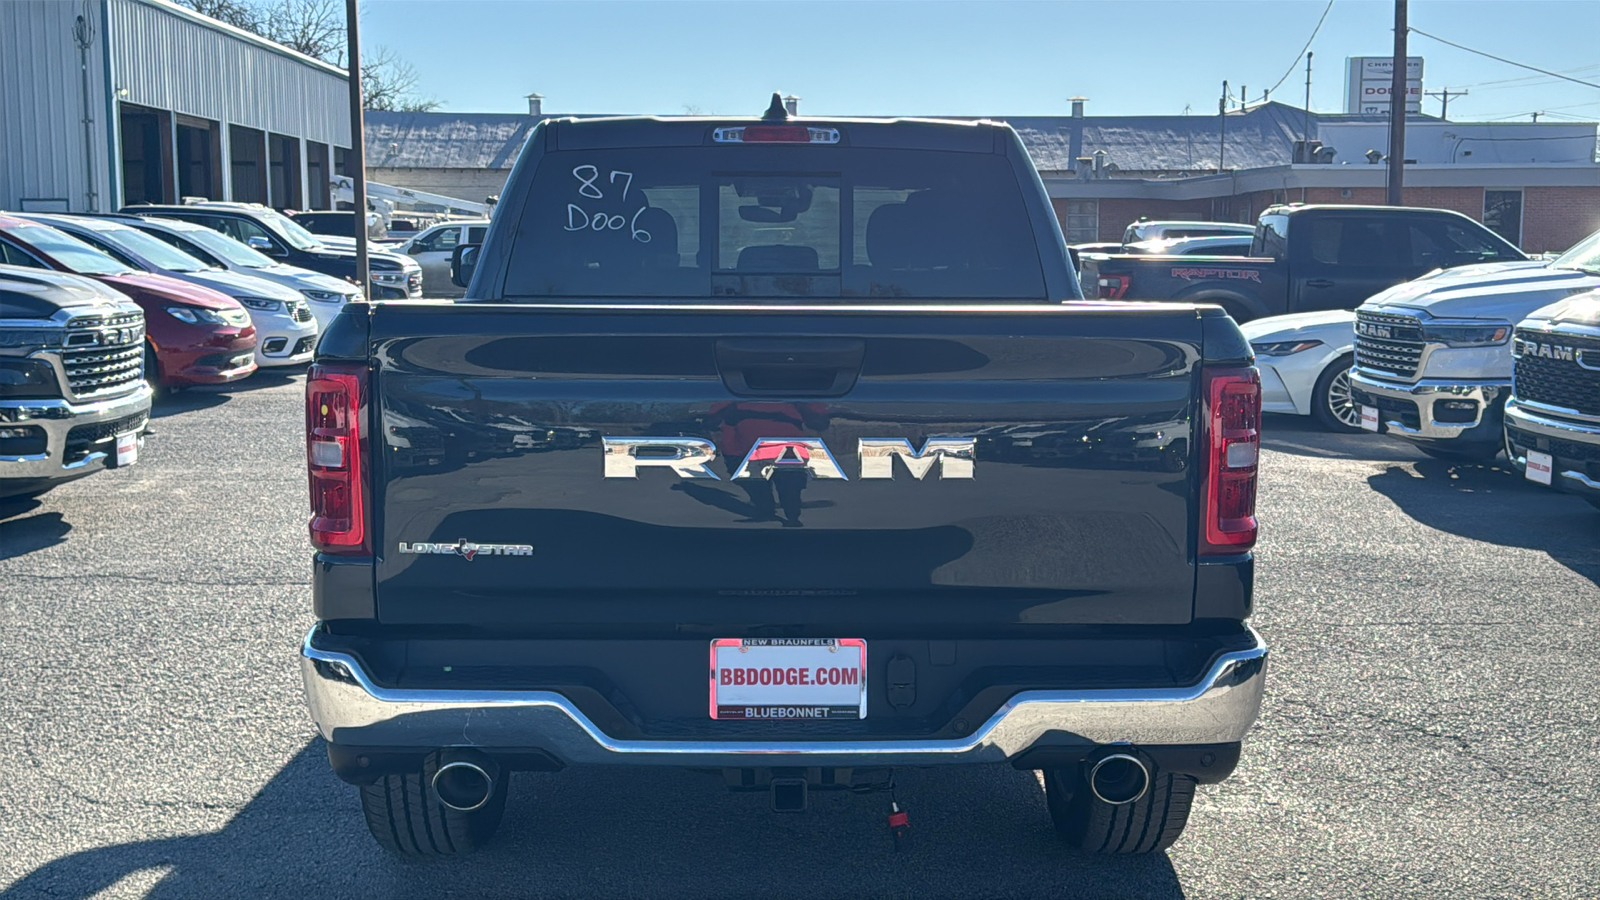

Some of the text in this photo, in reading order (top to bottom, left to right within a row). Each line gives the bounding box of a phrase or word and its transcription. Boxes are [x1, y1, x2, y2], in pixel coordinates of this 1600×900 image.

[573, 164, 633, 203] 87
[1171, 267, 1262, 284] RAPTOR
[1359, 322, 1391, 339] RAM
[1523, 340, 1574, 361] RAM
[601, 436, 978, 481] RAM
[399, 542, 533, 556] LONE STAR
[720, 667, 858, 686] BBDODGE.COM
[745, 707, 830, 718] BLUEBONNET
